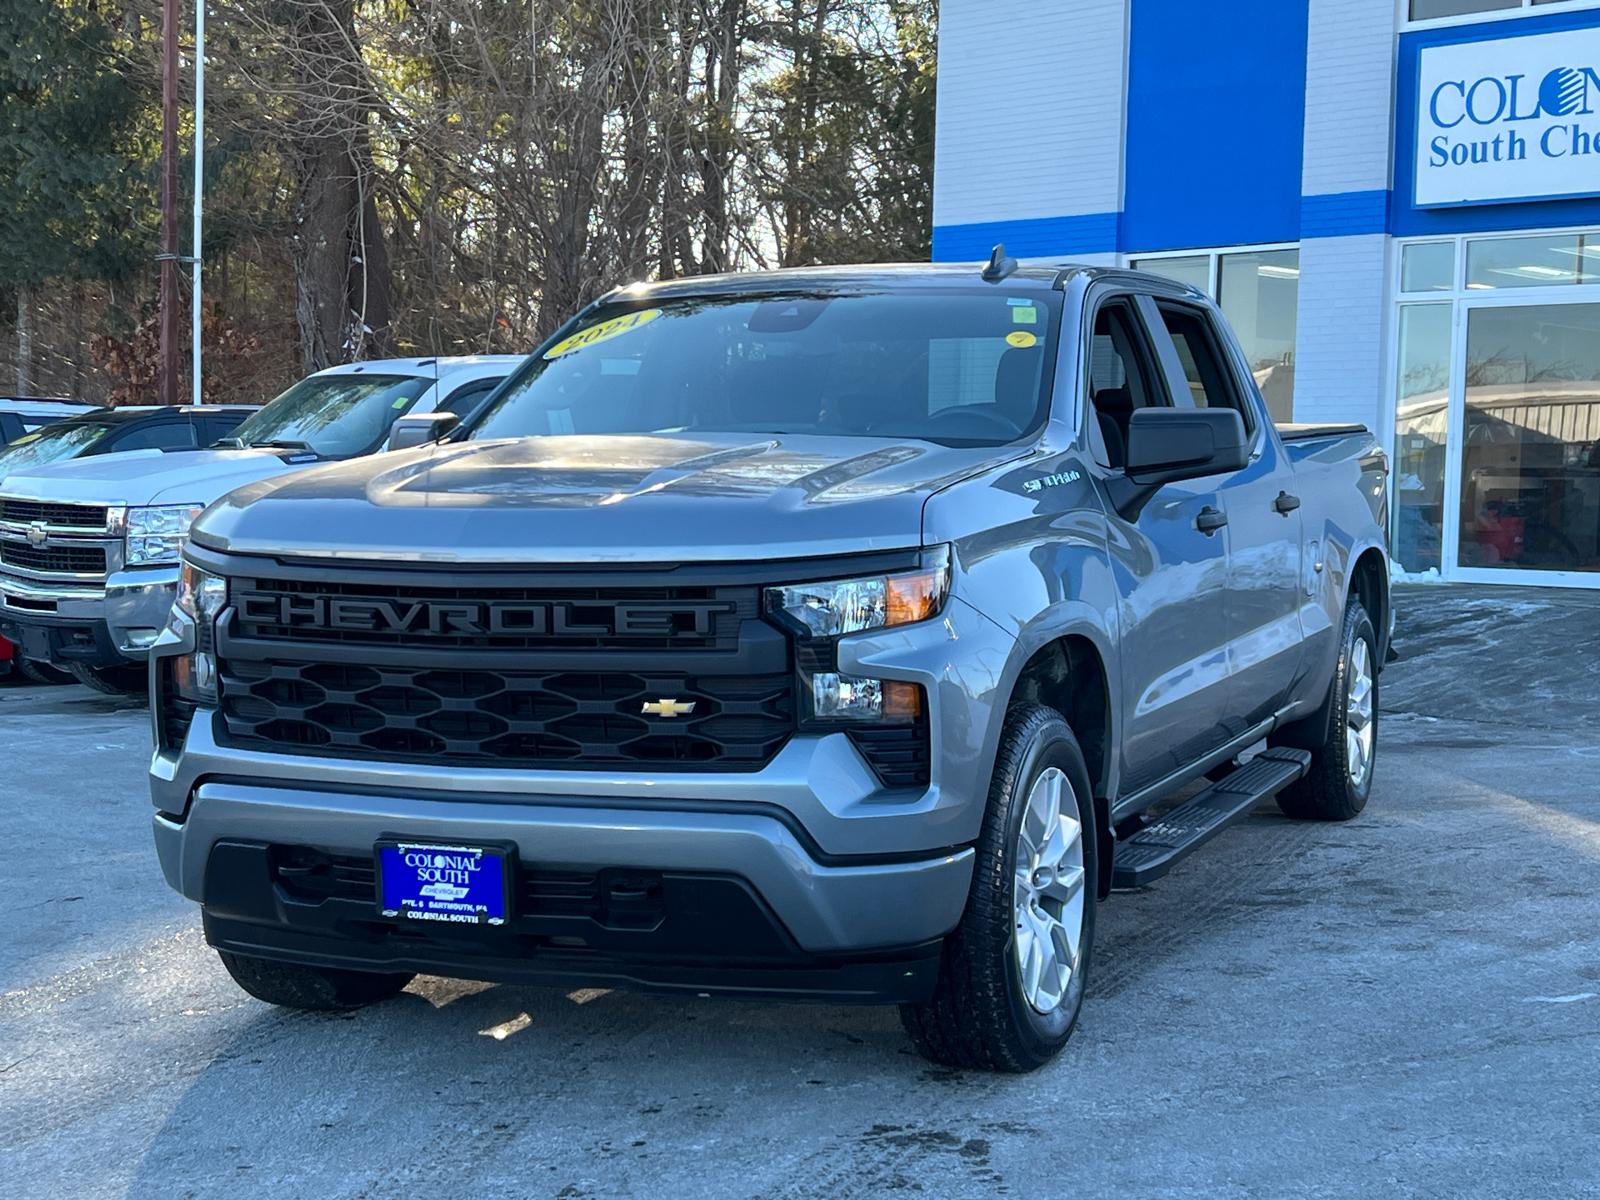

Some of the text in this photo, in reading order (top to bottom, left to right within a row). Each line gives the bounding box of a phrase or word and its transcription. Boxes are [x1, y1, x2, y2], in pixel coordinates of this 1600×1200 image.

[1429, 129, 1527, 168] South
[237, 592, 736, 637] CHEVROLET
[405, 854, 480, 871] COLONIAL
[417, 868, 469, 884] SOUTH
[424, 887, 464, 895] CHEVROLET
[407, 911, 449, 921] COLONIAL
